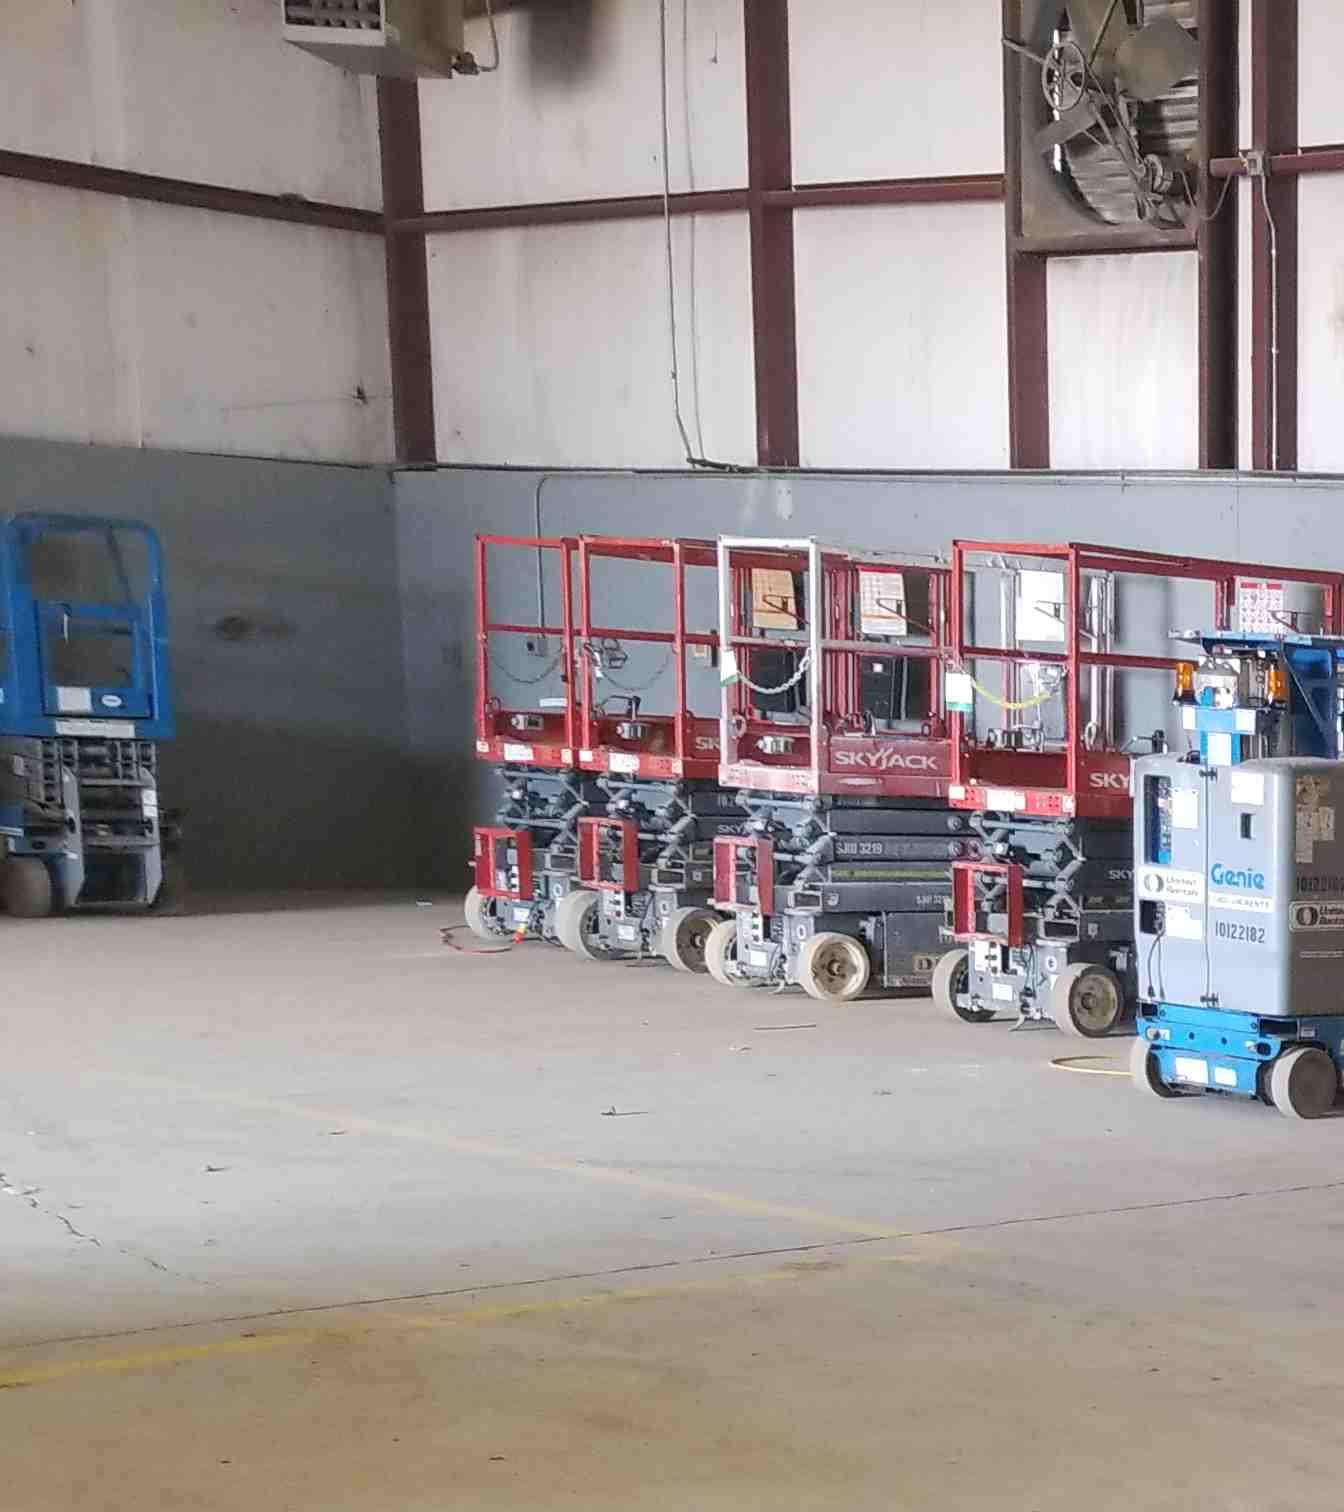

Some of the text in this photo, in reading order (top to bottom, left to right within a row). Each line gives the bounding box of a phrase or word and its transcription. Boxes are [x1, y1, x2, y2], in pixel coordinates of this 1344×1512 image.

[834, 747, 939, 771] SKYJACK
[1210, 862, 1265, 890] Genie
[1215, 920, 1266, 943] 10122182
